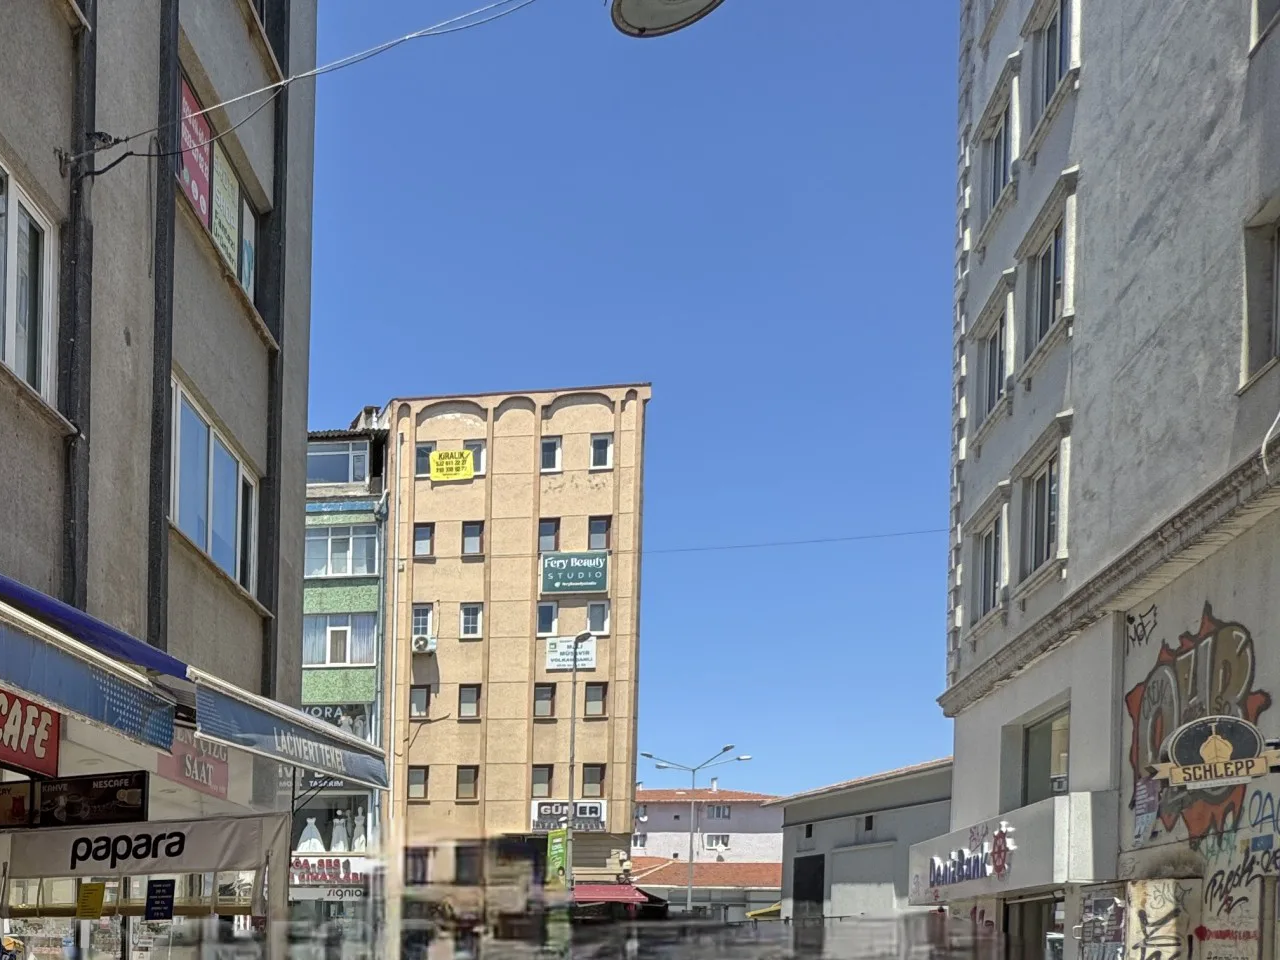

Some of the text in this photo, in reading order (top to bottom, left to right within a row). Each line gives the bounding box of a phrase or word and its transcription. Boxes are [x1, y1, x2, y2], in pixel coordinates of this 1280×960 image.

[544, 556, 606, 570] Fery Beauty
[548, 571, 603, 580] STUDIO
[185, 753, 214, 786] SAAT
[320, 743, 347, 773] TEKEL
[1182, 759, 1256, 782] SCHLEPP
[42, 783, 69, 793] KAHVE
[70, 829, 186, 870] papara
